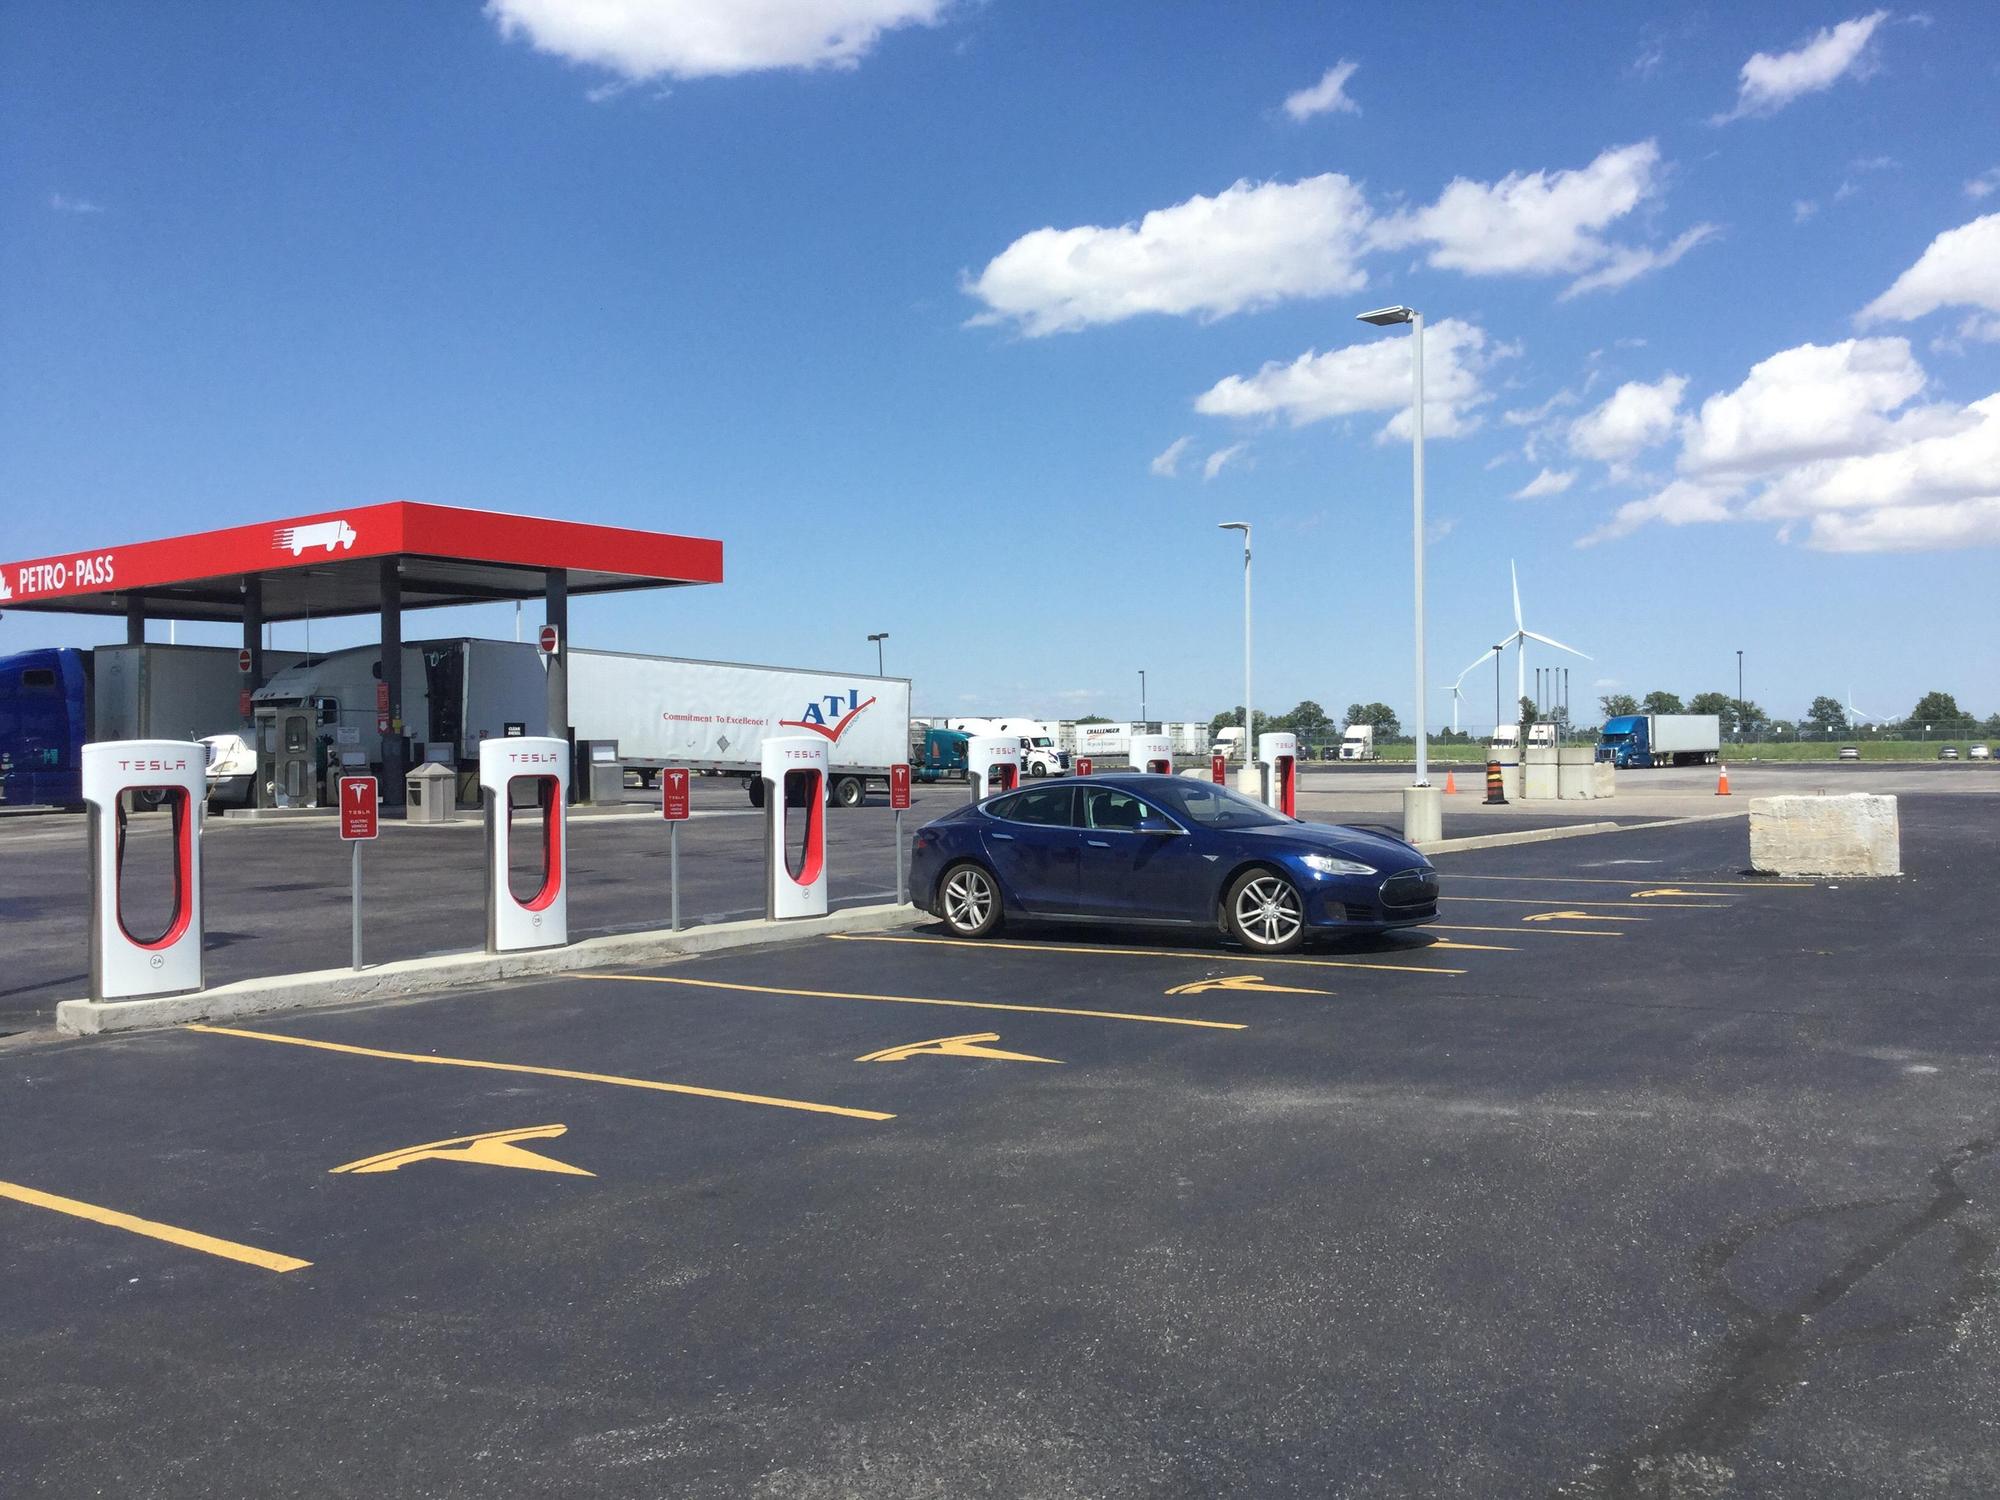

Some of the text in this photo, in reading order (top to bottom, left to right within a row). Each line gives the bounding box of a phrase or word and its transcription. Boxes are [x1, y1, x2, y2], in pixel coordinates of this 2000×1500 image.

[19, 554, 114, 594] PETRO-PASS
[801, 688, 859, 725] ATI
[663, 712, 712, 723] Commitment
[715, 715, 725, 723] To
[726, 716, 764, 726] Excellence
[1086, 727, 1120, 735] CHALLENGER
[785, 750, 821, 759] TESLA
[989, 747, 1016, 755] TESLA
[509, 753, 557, 763] TESLA
[118, 760, 186, 771] TESLA
